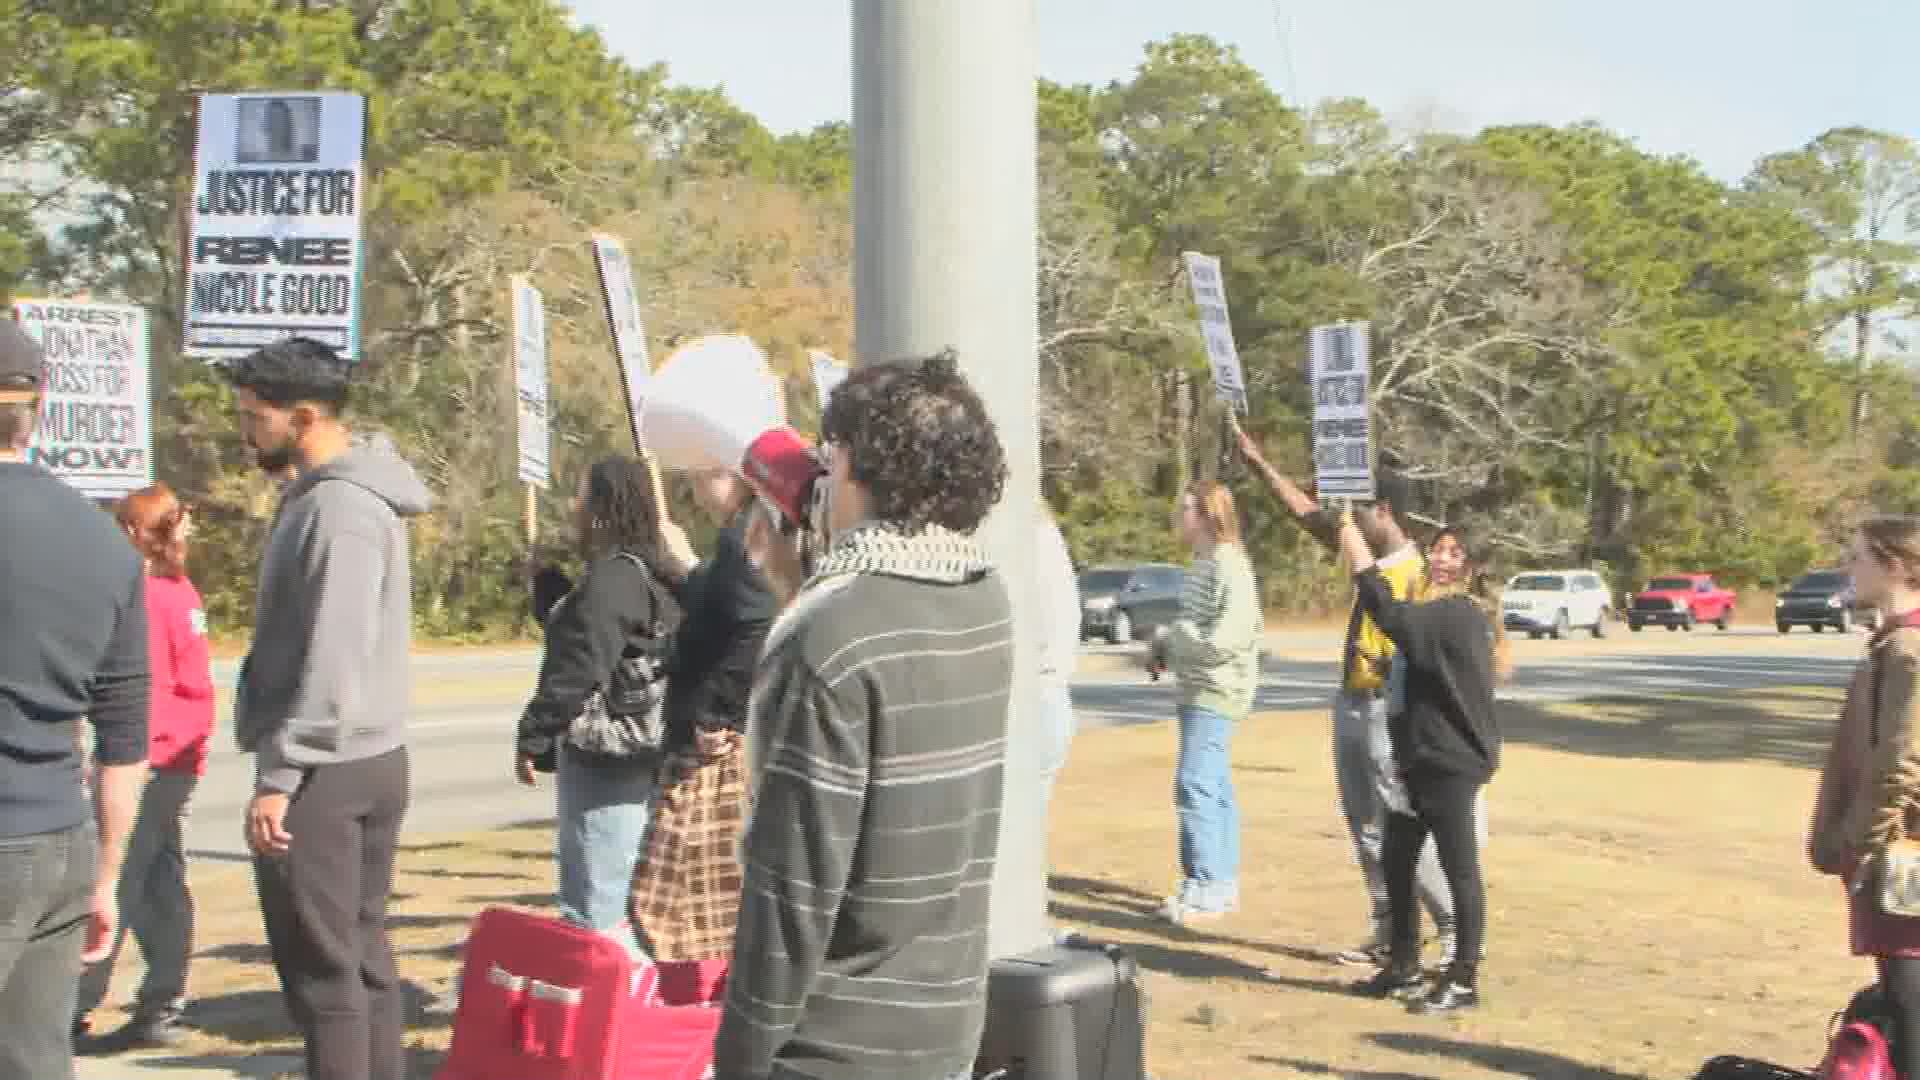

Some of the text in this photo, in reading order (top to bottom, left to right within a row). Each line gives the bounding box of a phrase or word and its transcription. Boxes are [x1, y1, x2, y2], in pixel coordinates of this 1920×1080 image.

[197, 169, 354, 217] JUSTICE FOR
[195, 236, 352, 266] RENEE
[191, 272, 349, 315] NICOLE GOOD
[25, 305, 137, 326] ARREST
[40, 400, 135, 445] MURDER
